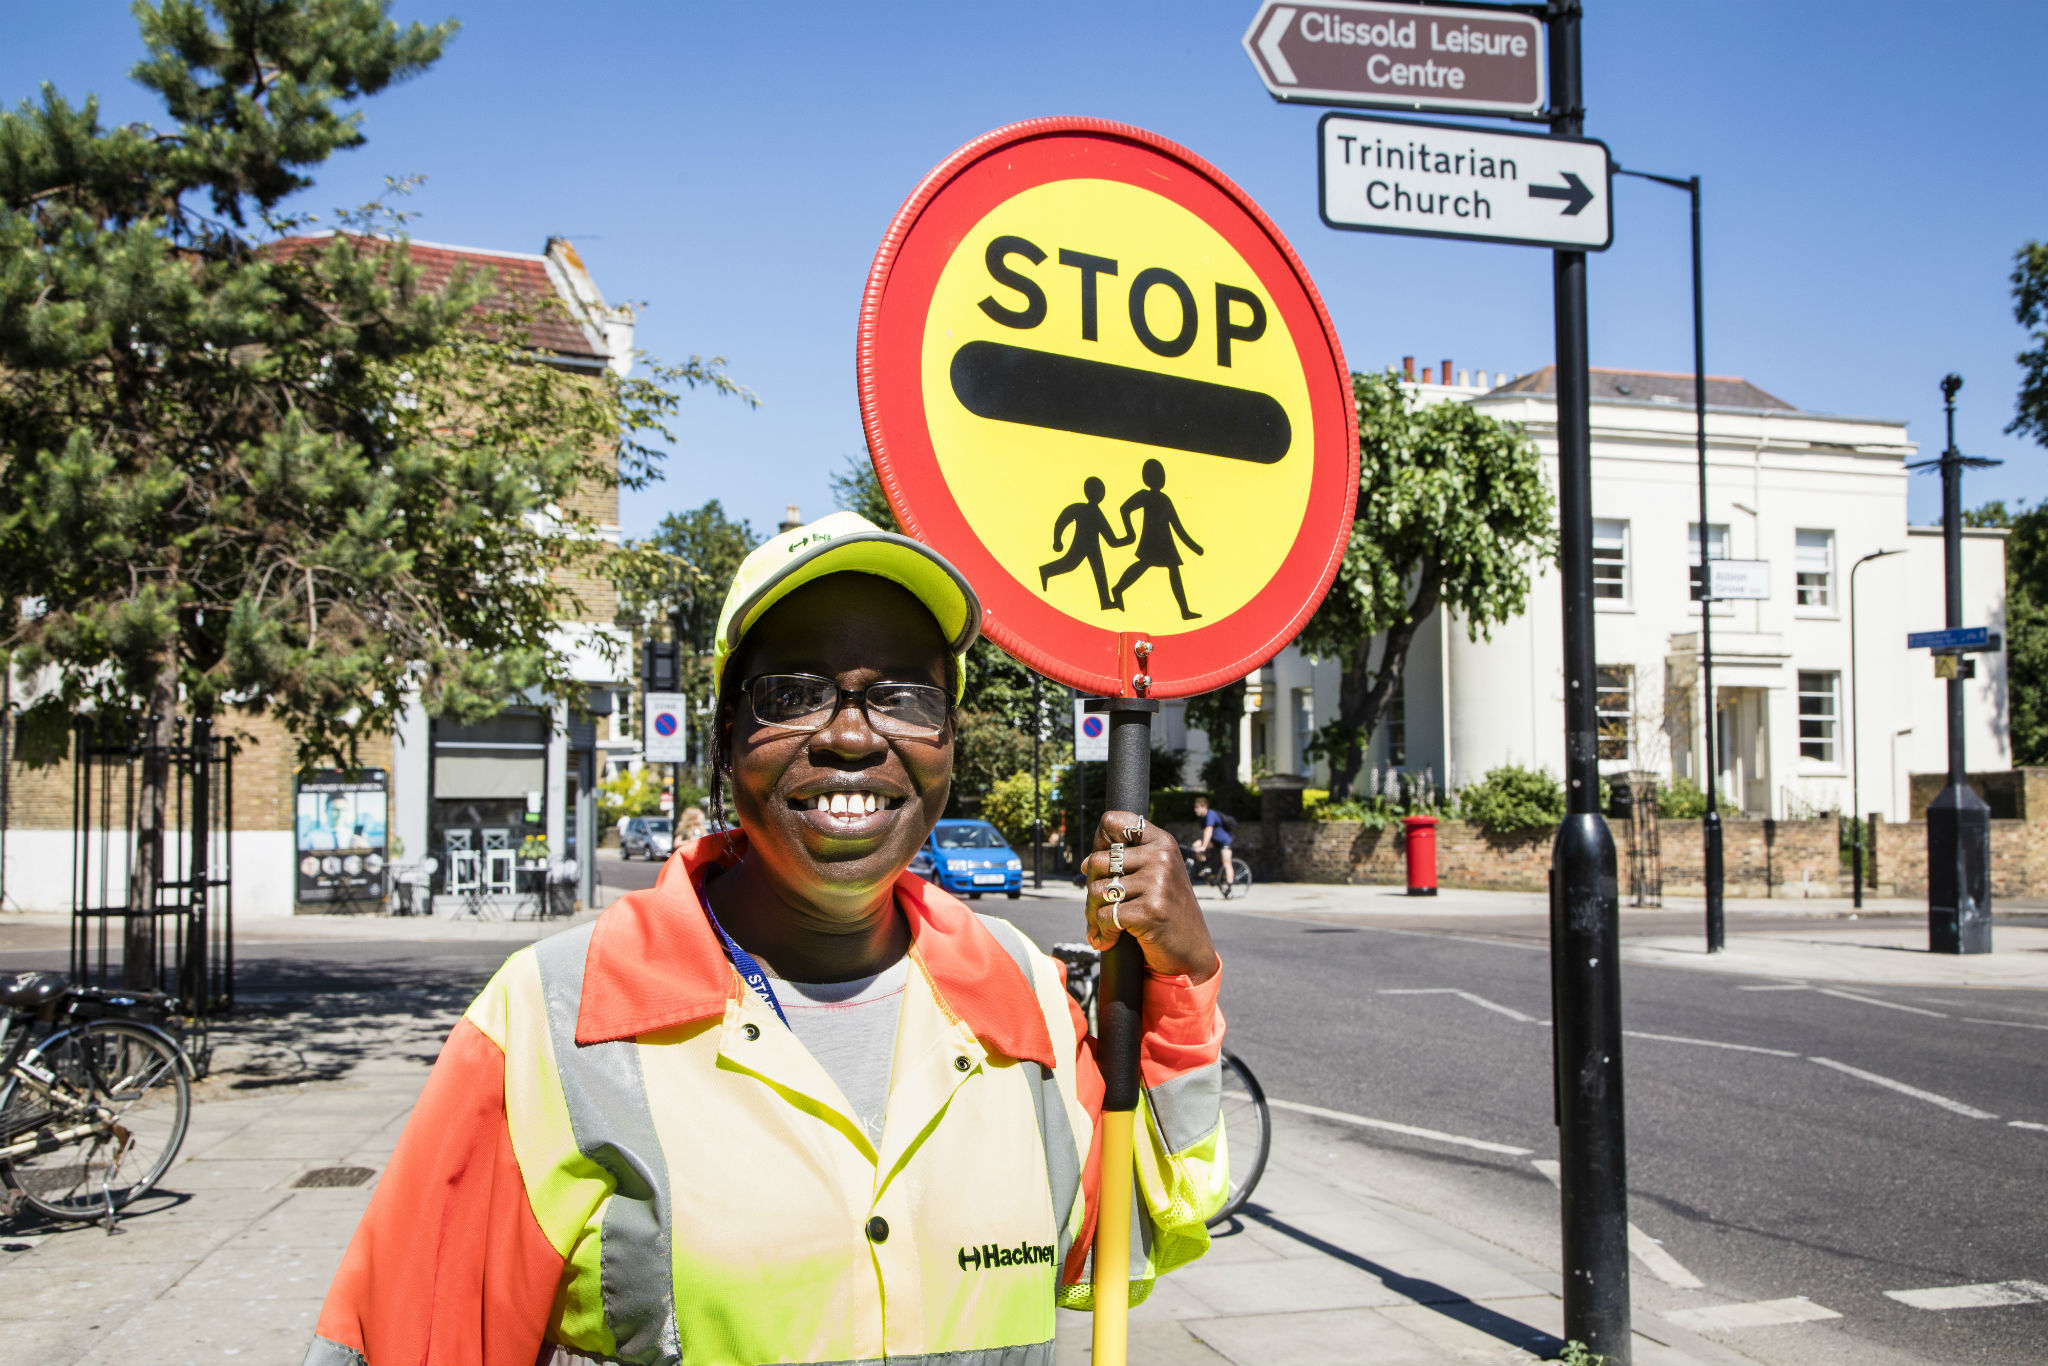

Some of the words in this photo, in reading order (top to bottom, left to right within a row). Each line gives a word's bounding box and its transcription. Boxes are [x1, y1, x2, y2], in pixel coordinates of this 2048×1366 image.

[1300, 12, 1416, 49] Clissold
[1431, 22, 1528, 57] Leisure
[1366, 54, 1465, 90] Centre
[1337, 135, 1517, 181] Trinitarian
[1366, 180, 1491, 219] Church
[977, 235, 1267, 368] STOP
[748, 974, 779, 1014] STA
[982, 1241, 1055, 1269] Hackney
